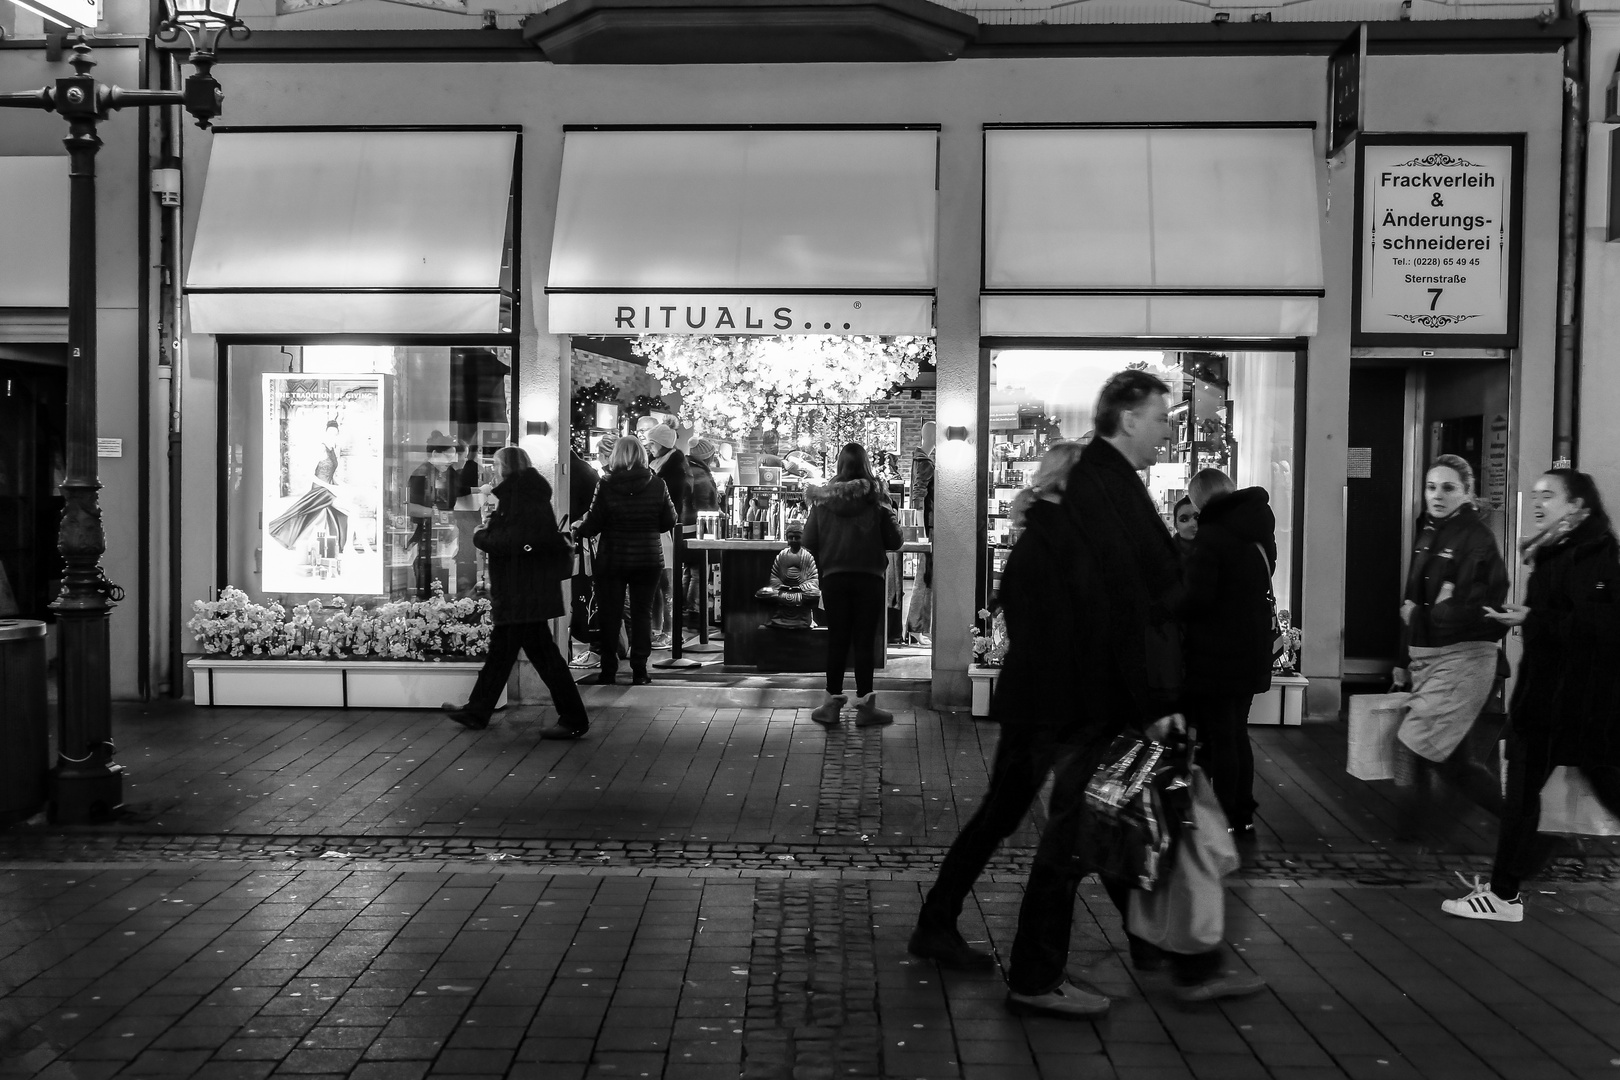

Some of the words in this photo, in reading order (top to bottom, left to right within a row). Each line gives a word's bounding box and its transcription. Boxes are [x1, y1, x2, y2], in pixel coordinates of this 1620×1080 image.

[1381, 172, 1495, 188] Frackverleih
[1430, 192, 1444, 208] &
[1381, 208, 1493, 231] Änderungs-
[1382, 235, 1490, 251] schneiderei
[1392, 257, 1411, 266] Tel.:
[1413, 257, 1441, 268] (0228)
[1443, 257, 1454, 266] 65
[1456, 257, 1467, 266] 49
[1469, 257, 1480, 266] 45
[1404, 274, 1467, 284] Sternstraße
[1427, 288, 1444, 311] 7
